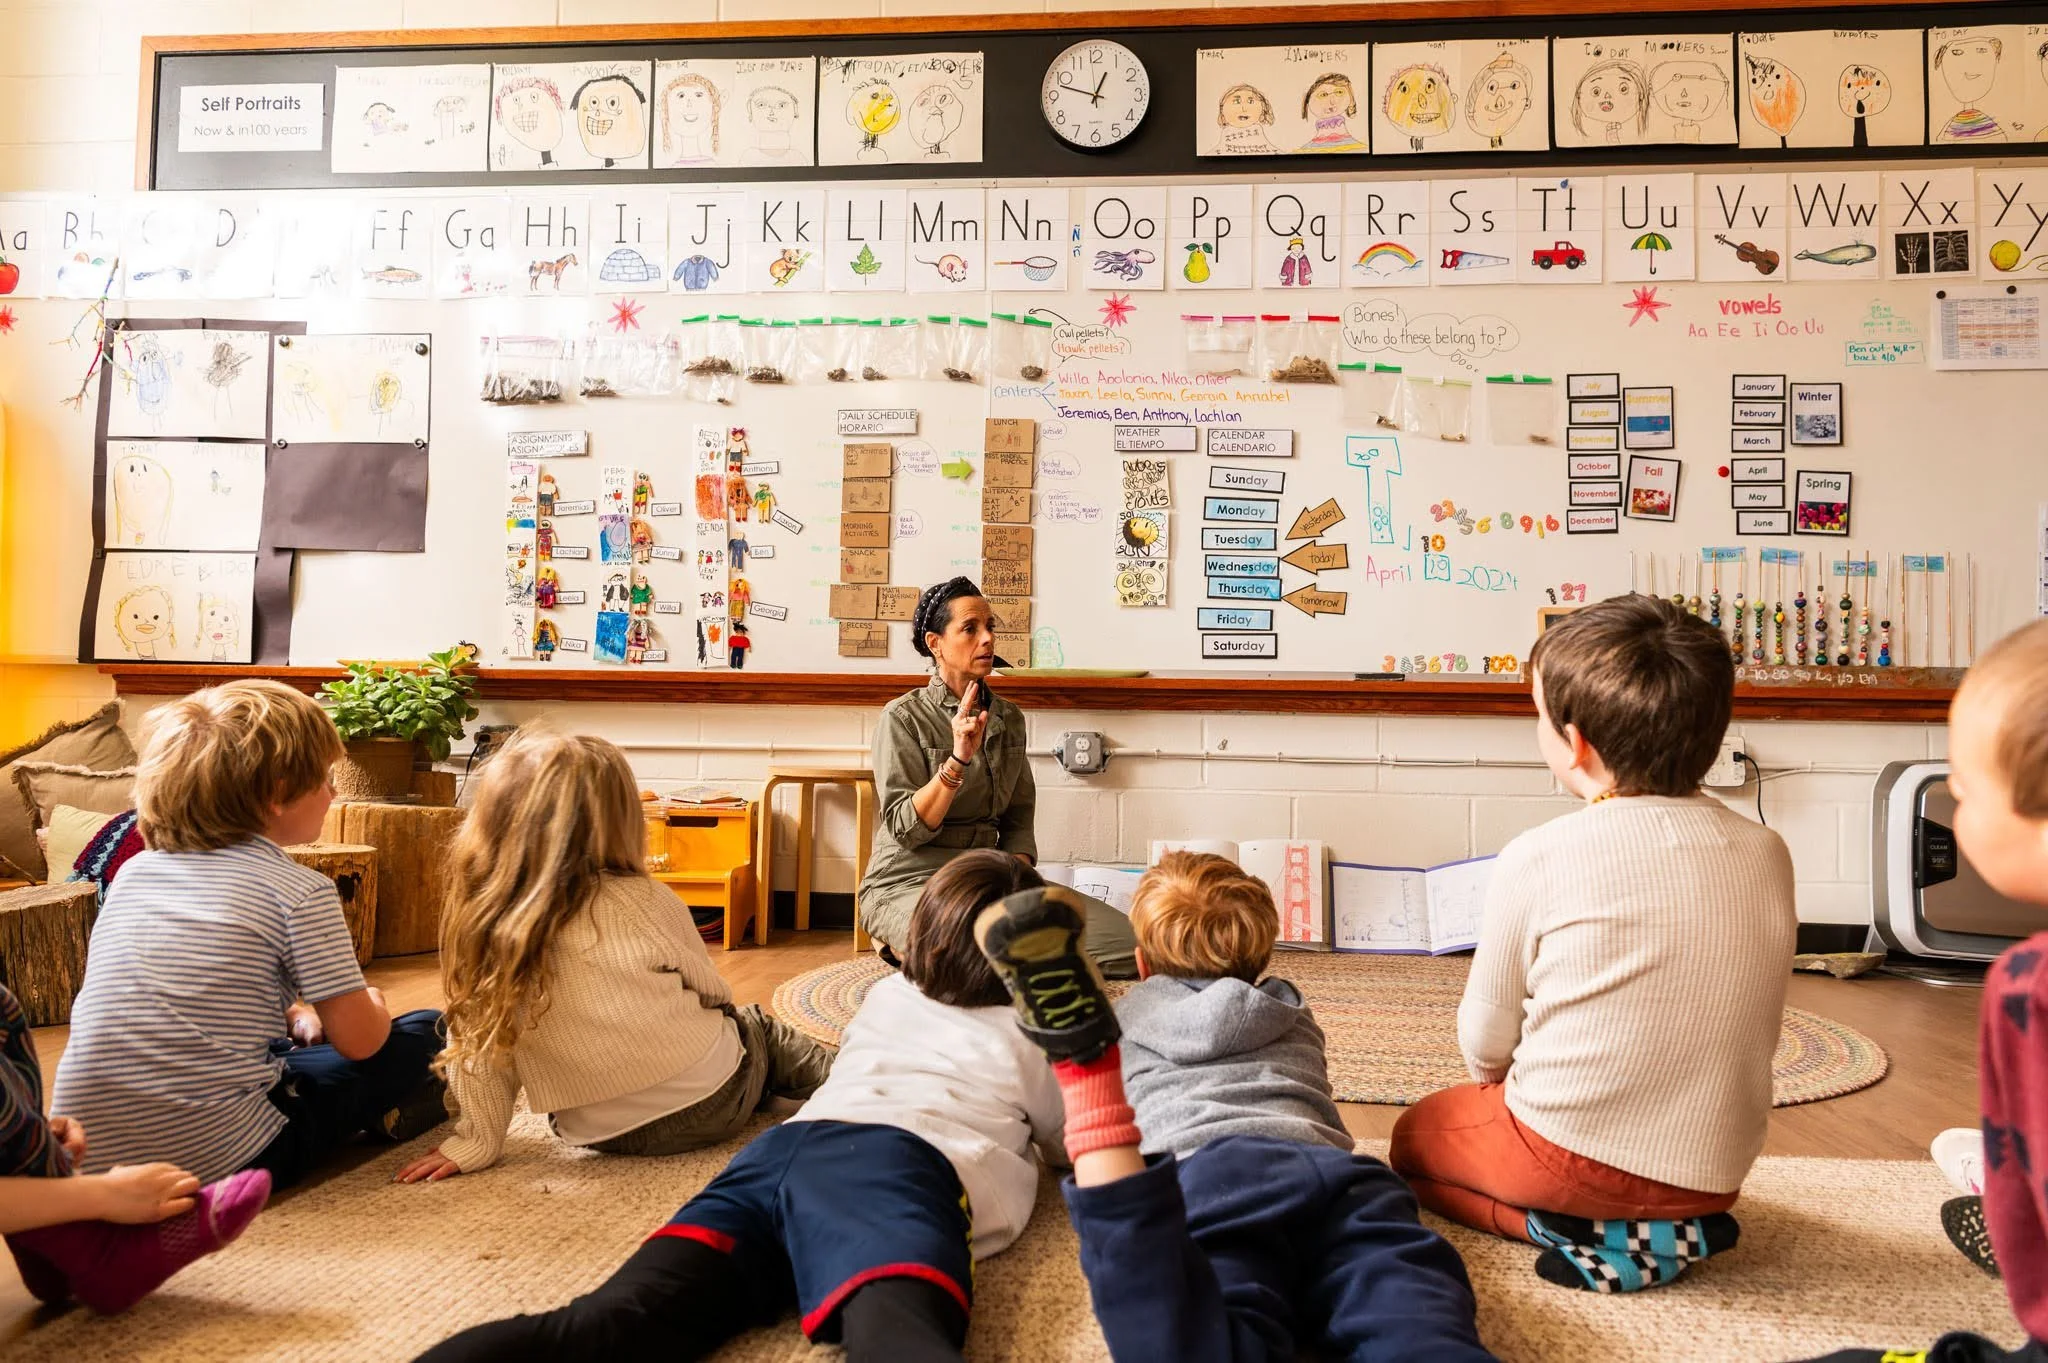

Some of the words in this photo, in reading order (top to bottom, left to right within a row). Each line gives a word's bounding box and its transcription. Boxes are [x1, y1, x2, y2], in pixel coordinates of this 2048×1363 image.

[1072, 56, 1082, 70] 11
[1089, 49, 1103, 64] 12
[1056, 71, 1073, 85] 10
[1125, 67, 1137, 82] 2
[1048, 89, 1060, 104] 9
[1133, 87, 1144, 102] 3
[201, 96, 231, 112] Self
[235, 95, 302, 112] Portraits
[1056, 109, 1066, 125] 8
[1125, 107, 1135, 122] 4
[193, 124, 223, 138] Now
[225, 124, 235, 137] &
[273, 124, 308, 139] years
[1071, 124, 1081, 139] 7
[1090, 128, 1101, 143] 6
[1111, 123, 1122, 138] 5
[1531, 186, 1578, 232] Tt
[1621, 184, 1678, 230] Uu
[1715, 183, 1770, 229] Vv
[1793, 182, 1878, 228] Ww
[1899, 179, 1960, 227] Xx
[1093, 197, 1156, 240] Oo
[1367, 193, 1417, 236] Rr
[1448, 189, 1496, 234] Ss
[1992, 181, 2048, 252] Yy
[525, 205, 577, 247] Hh
[615, 203, 642, 244] Ii
[762, 199, 811, 243] Kk
[846, 199, 884, 242] Ll
[912, 200, 979, 243] Mm
[1001, 198, 1053, 241] Nn
[371, 209, 414, 251] Ff
[1192, 195, 1232, 263] Pp
[1265, 193, 1338, 262] Qq
[690, 203, 732, 269] Jj
[1718, 293, 1782, 315] vowels
[1353, 303, 1400, 323] Bones!
[1075, 326, 1110, 341] pellets?
[1688, 322, 1708, 338] Aa
[1717, 322, 1741, 338] Ee
[1752, 321, 1768, 337] Ii
[1775, 319, 1799, 336] Oo
[1805, 318, 1825, 335] Uu
[1350, 326, 1378, 345] Who
[1383, 327, 1398, 345] do
[1400, 325, 1431, 345] these
[1435, 325, 1476, 352] belong
[1057, 343, 1086, 353] Hawk
[1088, 341, 1126, 356] pellets?
[1058, 371, 1090, 385] Willa
[1195, 373, 1232, 386] Oliver
[993, 385, 1042, 399] Centers
[1097, 386, 1135, 402] Leela,
[1235, 388, 1291, 402] Annabel
[1741, 383, 1776, 393] January
[1625, 393, 1671, 405] Summer
[1797, 391, 1833, 401] Winter
[841, 411, 866, 421] DAILY
[867, 410, 916, 420] SCHEDULE
[1113, 407, 1140, 421] Ben,
[1194, 407, 1242, 423] Lachlan
[1580, 408, 1610, 418] August
[1739, 409, 1777, 419] February
[839, 423, 884, 433] HORARIO
[1116, 427, 1161, 437] WEATHER
[1210, 430, 1265, 441] CALENDAR
[1116, 440, 1127, 449] EL
[1128, 440, 1165, 449] TIEMPO
[1210, 443, 1276, 453] CALENDARIO
[1743, 437, 1771, 445] March
[1576, 462, 1612, 471] October
[1644, 466, 1664, 477] Fall
[1748, 466, 1768, 475] April
[1225, 473, 1269, 487] Sunday
[1805, 477, 1842, 491] Spring
[984, 487, 1020, 495] LITERACY
[1573, 489, 1618, 498] November
[1748, 493, 1768, 502] May
[556, 504, 589, 513] Jeremias
[1216, 504, 1266, 518] Monday
[777, 515, 798, 532] Jaxon
[1299, 507, 1338, 535] yesterday
[1569, 516, 1614, 525] December
[1752, 519, 1774, 527] June
[985, 527, 1007, 535] CLEAN
[1215, 534, 1263, 546] Tuesday
[555, 547, 585, 556] Lachlan
[655, 548, 677, 557] Sunny
[754, 548, 770, 556] Ben
[849, 549, 877, 557] SNACK
[1308, 551, 1337, 564] today
[1207, 562, 1277, 575] Wednesday
[1366, 555, 1412, 588] April
[1456, 565, 1518, 591] 2024
[983, 587, 1028, 595] REFLECTION
[1218, 582, 1271, 597] Thursday
[659, 604, 677, 612] Willa
[985, 597, 1019, 606] WELLNESS
[1298, 594, 1340, 608] tomorrow
[753, 604, 785, 618] Georgia
[1216, 609, 1253, 627] Friday
[564, 641, 582, 649] Nika
[1213, 640, 1266, 653] Saturday
